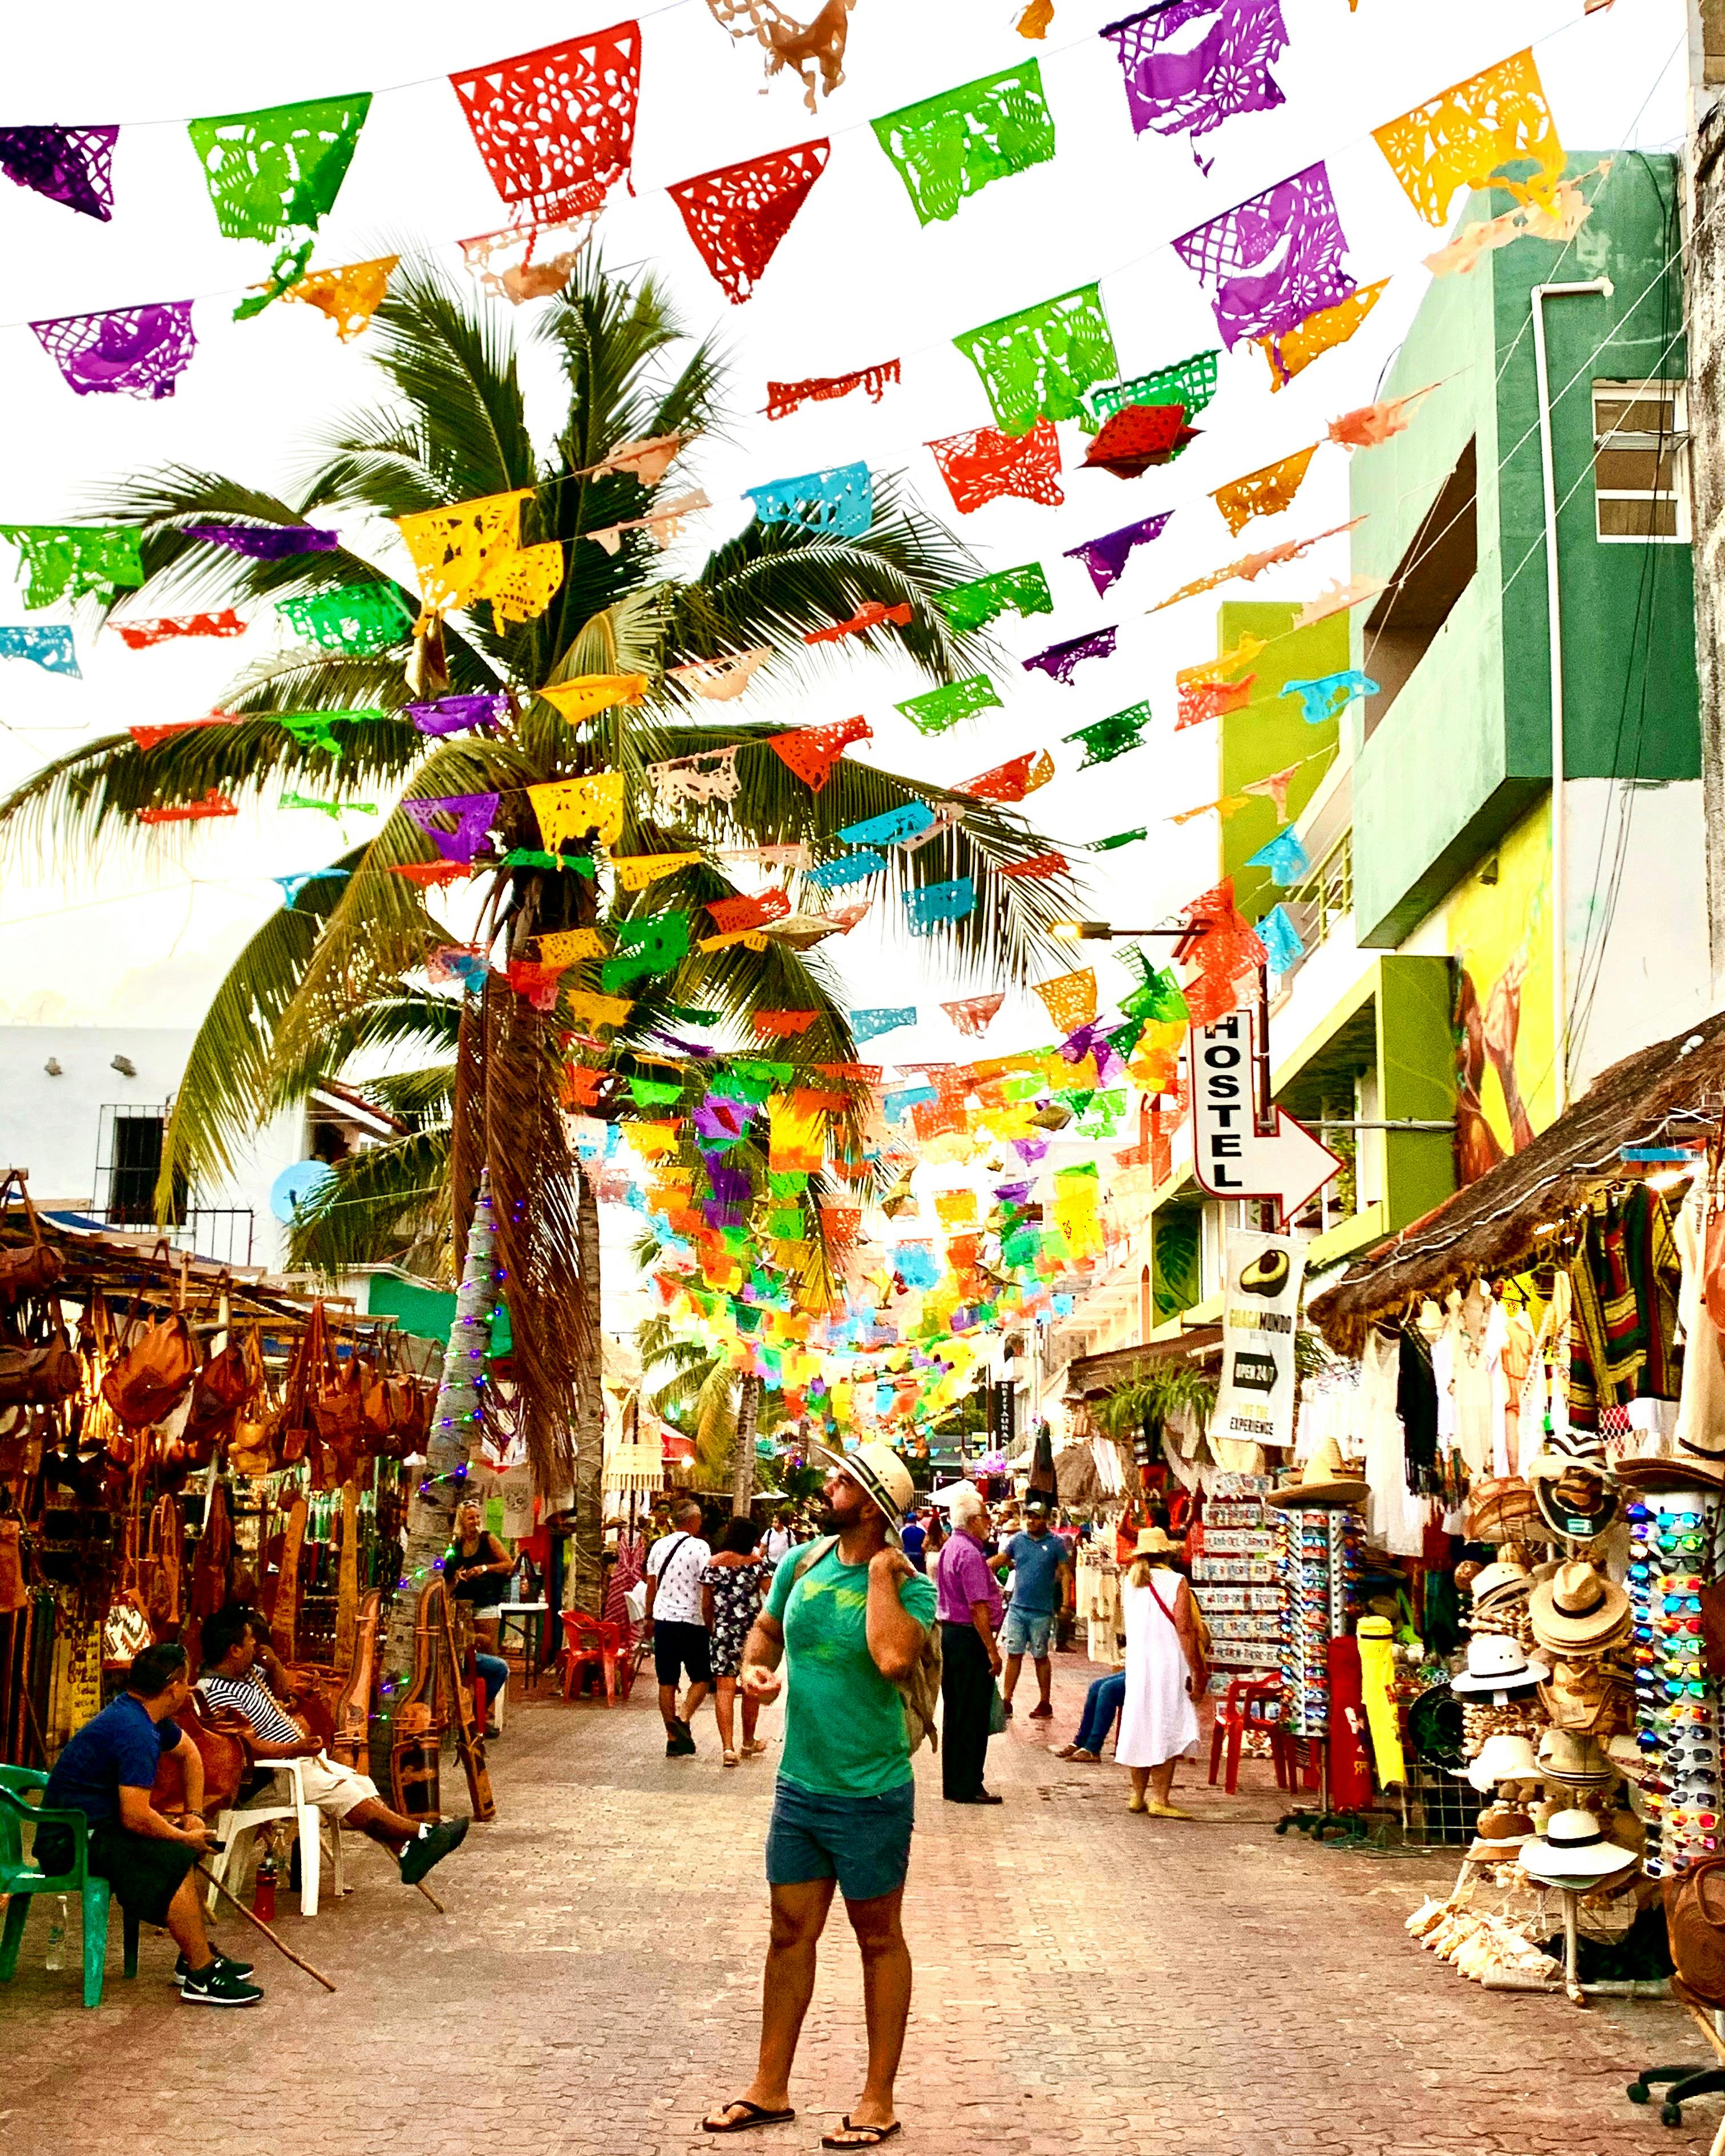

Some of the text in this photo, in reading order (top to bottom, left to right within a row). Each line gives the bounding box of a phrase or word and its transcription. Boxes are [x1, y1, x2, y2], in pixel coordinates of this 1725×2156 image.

[1204, 1016, 1243, 1188] HOSTEL
[1235, 1363, 1256, 1379] OPEN
[1230, 1417, 1274, 1436] EXPERIENCE
